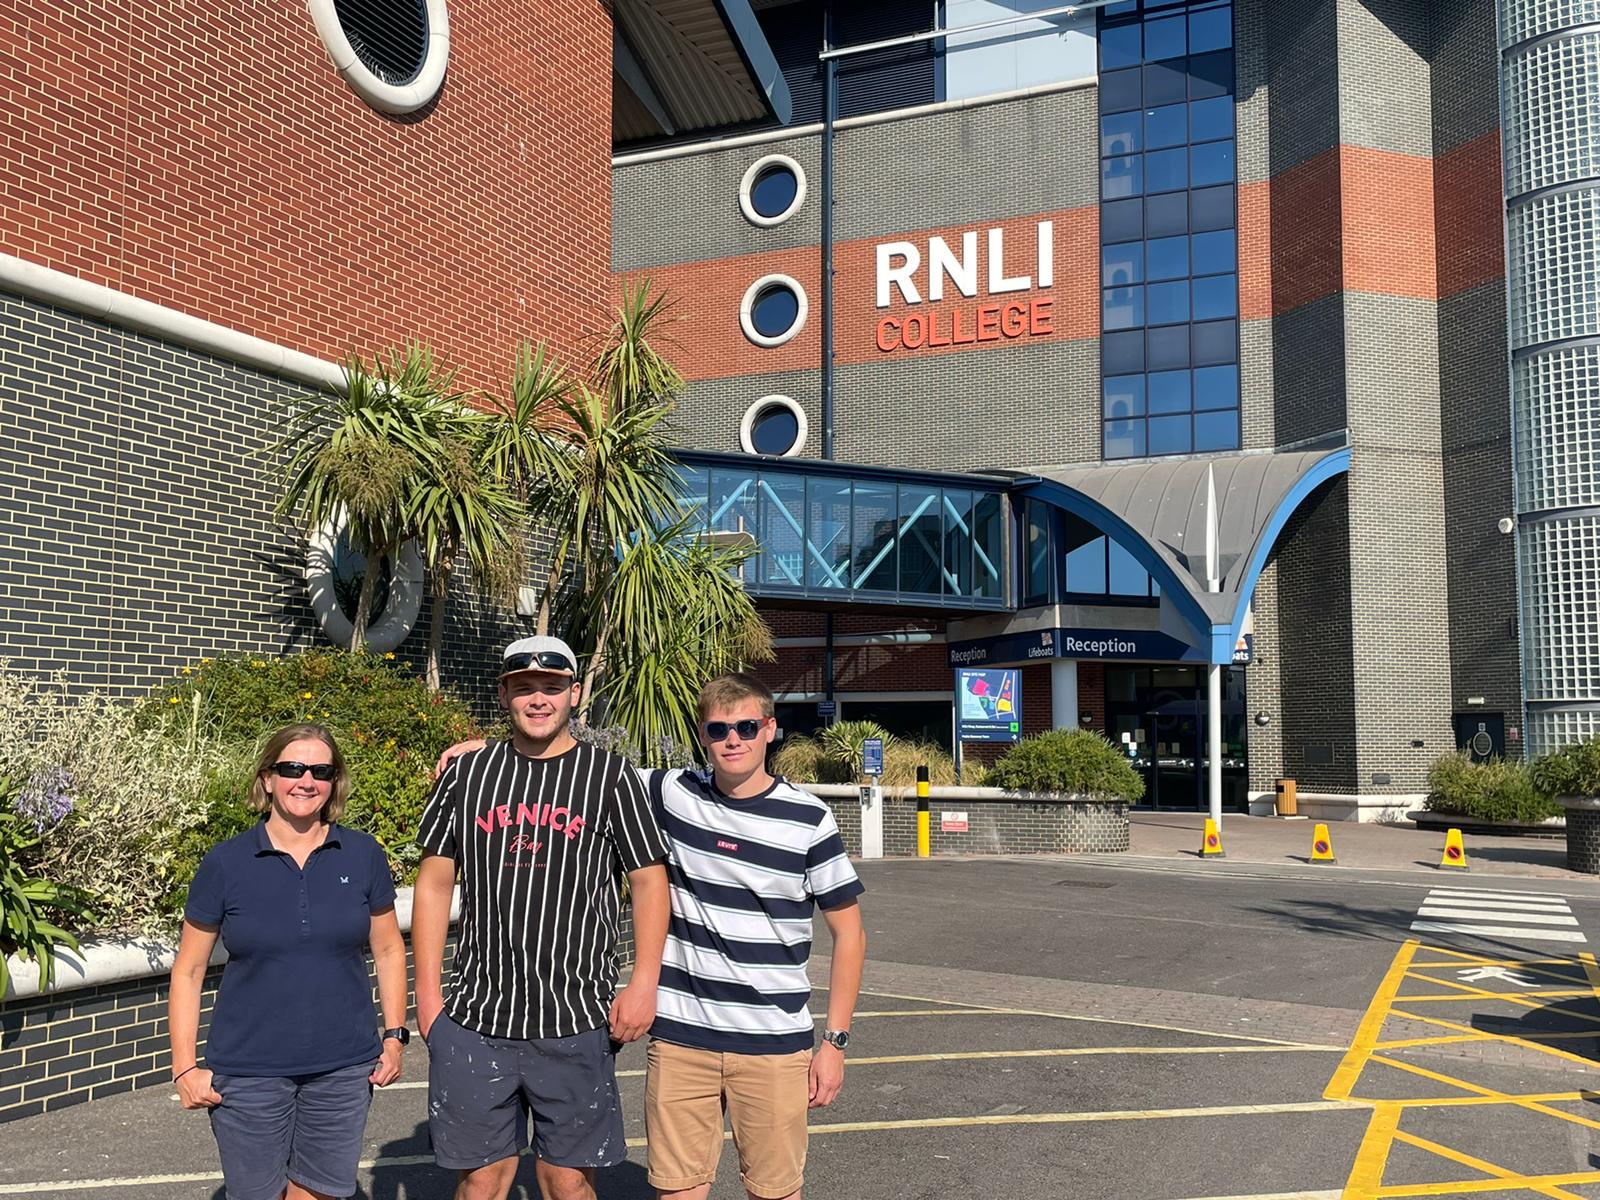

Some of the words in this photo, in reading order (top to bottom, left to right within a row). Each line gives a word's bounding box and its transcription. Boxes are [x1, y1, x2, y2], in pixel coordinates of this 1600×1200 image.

[876, 220, 1053, 308] RNLI
[876, 297, 1053, 352] COLLEGE
[951, 647, 986, 664] Reception
[1028, 646, 1054, 658] Lifeboats
[1066, 637, 1136, 656] Reception
[475, 802, 587, 840] VENICE
[508, 834, 543, 856] Bay
